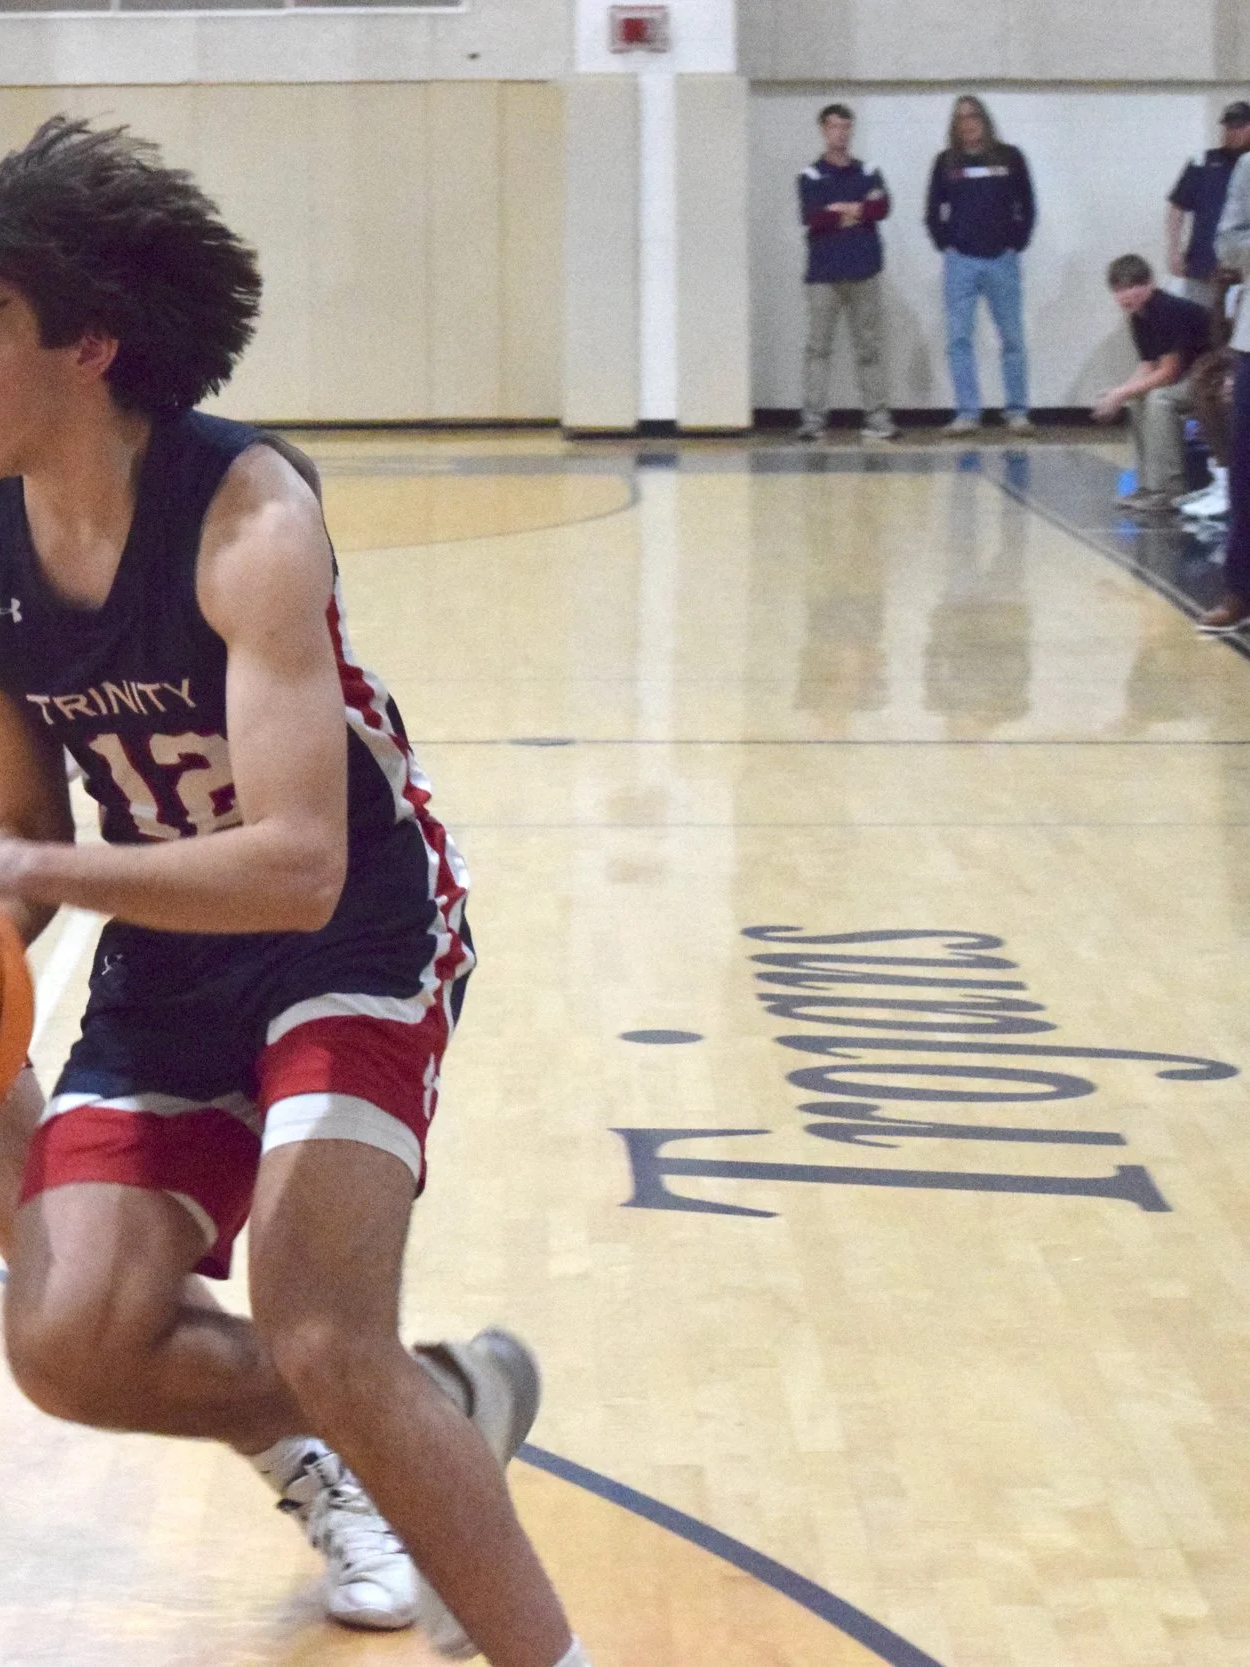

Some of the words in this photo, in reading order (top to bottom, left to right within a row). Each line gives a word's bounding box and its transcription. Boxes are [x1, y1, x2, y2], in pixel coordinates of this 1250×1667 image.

[26, 678, 197, 724] TRINITY
[88, 732, 245, 841] 12
[607, 925, 1240, 1218] Trojans
